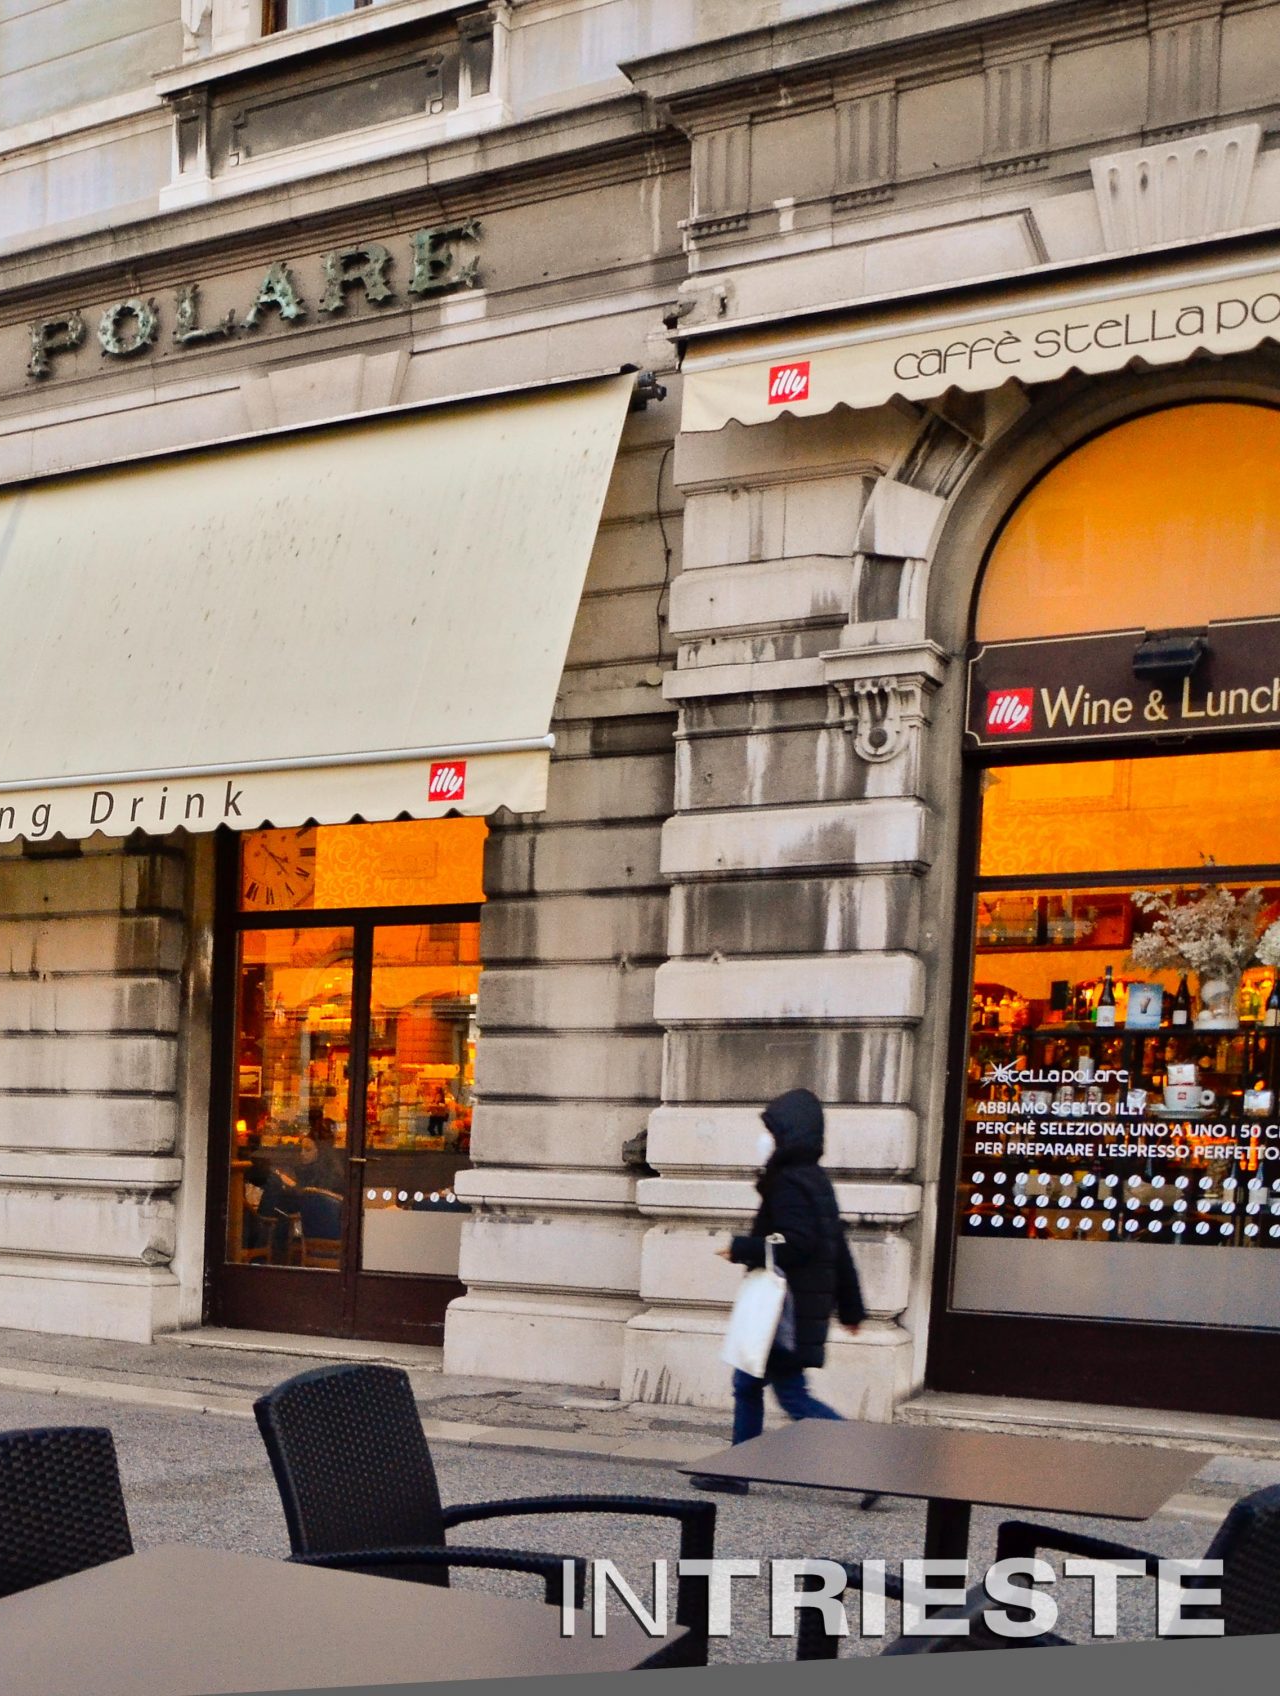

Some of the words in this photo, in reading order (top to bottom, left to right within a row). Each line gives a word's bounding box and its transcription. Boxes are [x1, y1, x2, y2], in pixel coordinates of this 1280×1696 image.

[26, 215, 482, 380] POLARE
[893, 330, 1022, 381] caffè
[769, 367, 808, 401] illy
[987, 695, 1030, 731] illy
[1040, 684, 1133, 729] Wine
[1143, 689, 1169, 722] &
[430, 767, 464, 799] illy
[89, 780, 245, 826] Drink
[976, 1101, 1048, 1115] ABBIAMO
[1050, 1102, 1111, 1116] SCELTO
[1115, 1102, 1147, 1116] ILLY
[976, 1118, 1036, 1135] PERCHÈ
[1039, 1121, 1126, 1137] SELEZIONA
[1129, 1123, 1169, 1138] UNO
[1170, 1124, 1184, 1138] A
[1188, 1124, 1227, 1138] UNO
[1240, 1124, 1262, 1139] 50
[1265, 1124, 1280, 1139] C
[975, 1142, 1004, 1156] PER
[1006, 1142, 1094, 1157] PREPARARE
[1097, 1144, 1190, 1159] L'ESPRESSO
